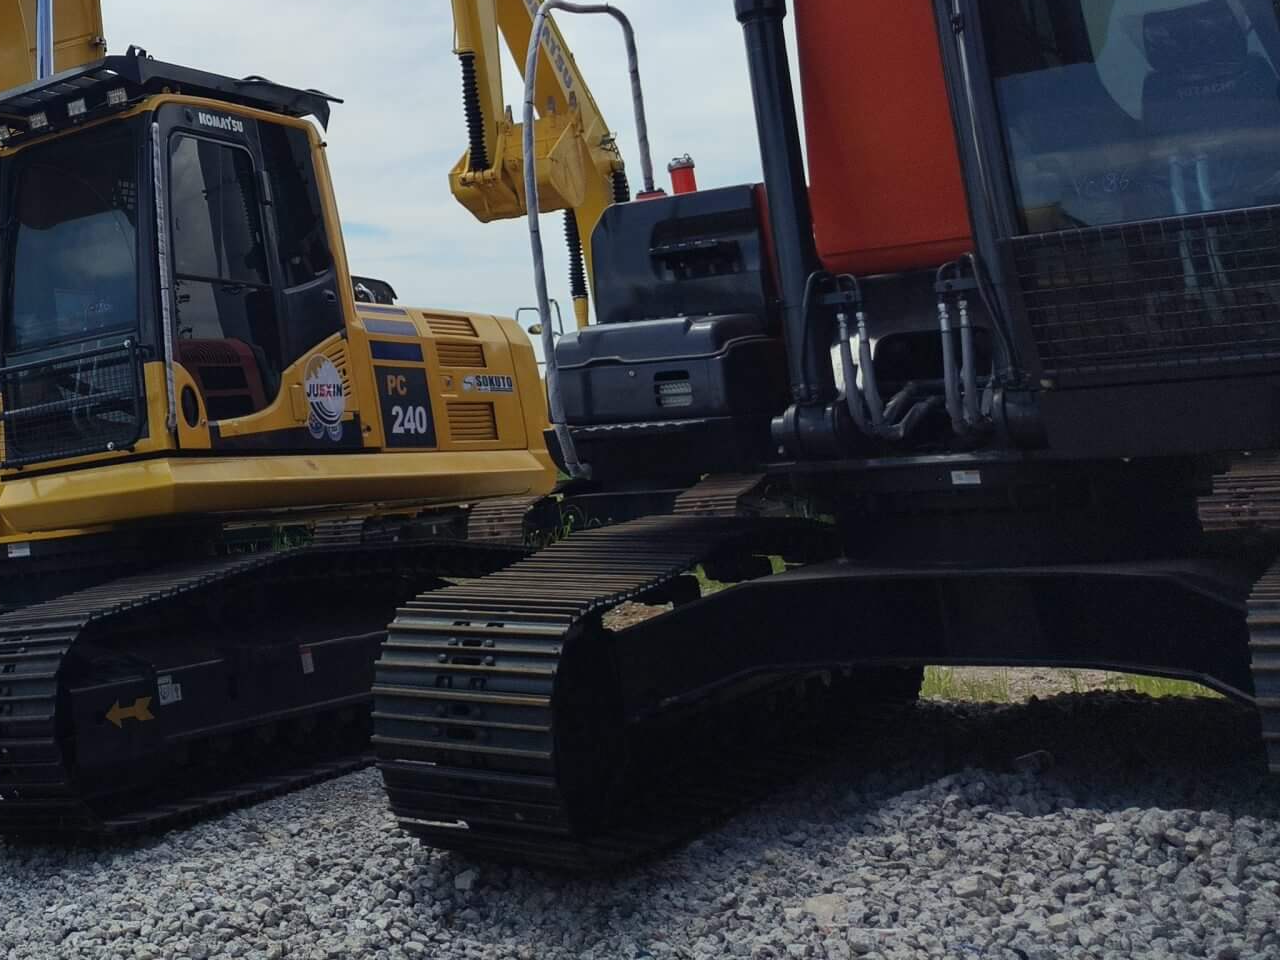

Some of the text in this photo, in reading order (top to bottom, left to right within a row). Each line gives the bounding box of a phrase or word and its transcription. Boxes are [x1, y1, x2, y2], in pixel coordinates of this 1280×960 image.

[198, 111, 243, 132] KOMATSU
[387, 375, 407, 395] PC
[475, 375, 513, 387] SOKUTO
[392, 406, 427, 434] 240
